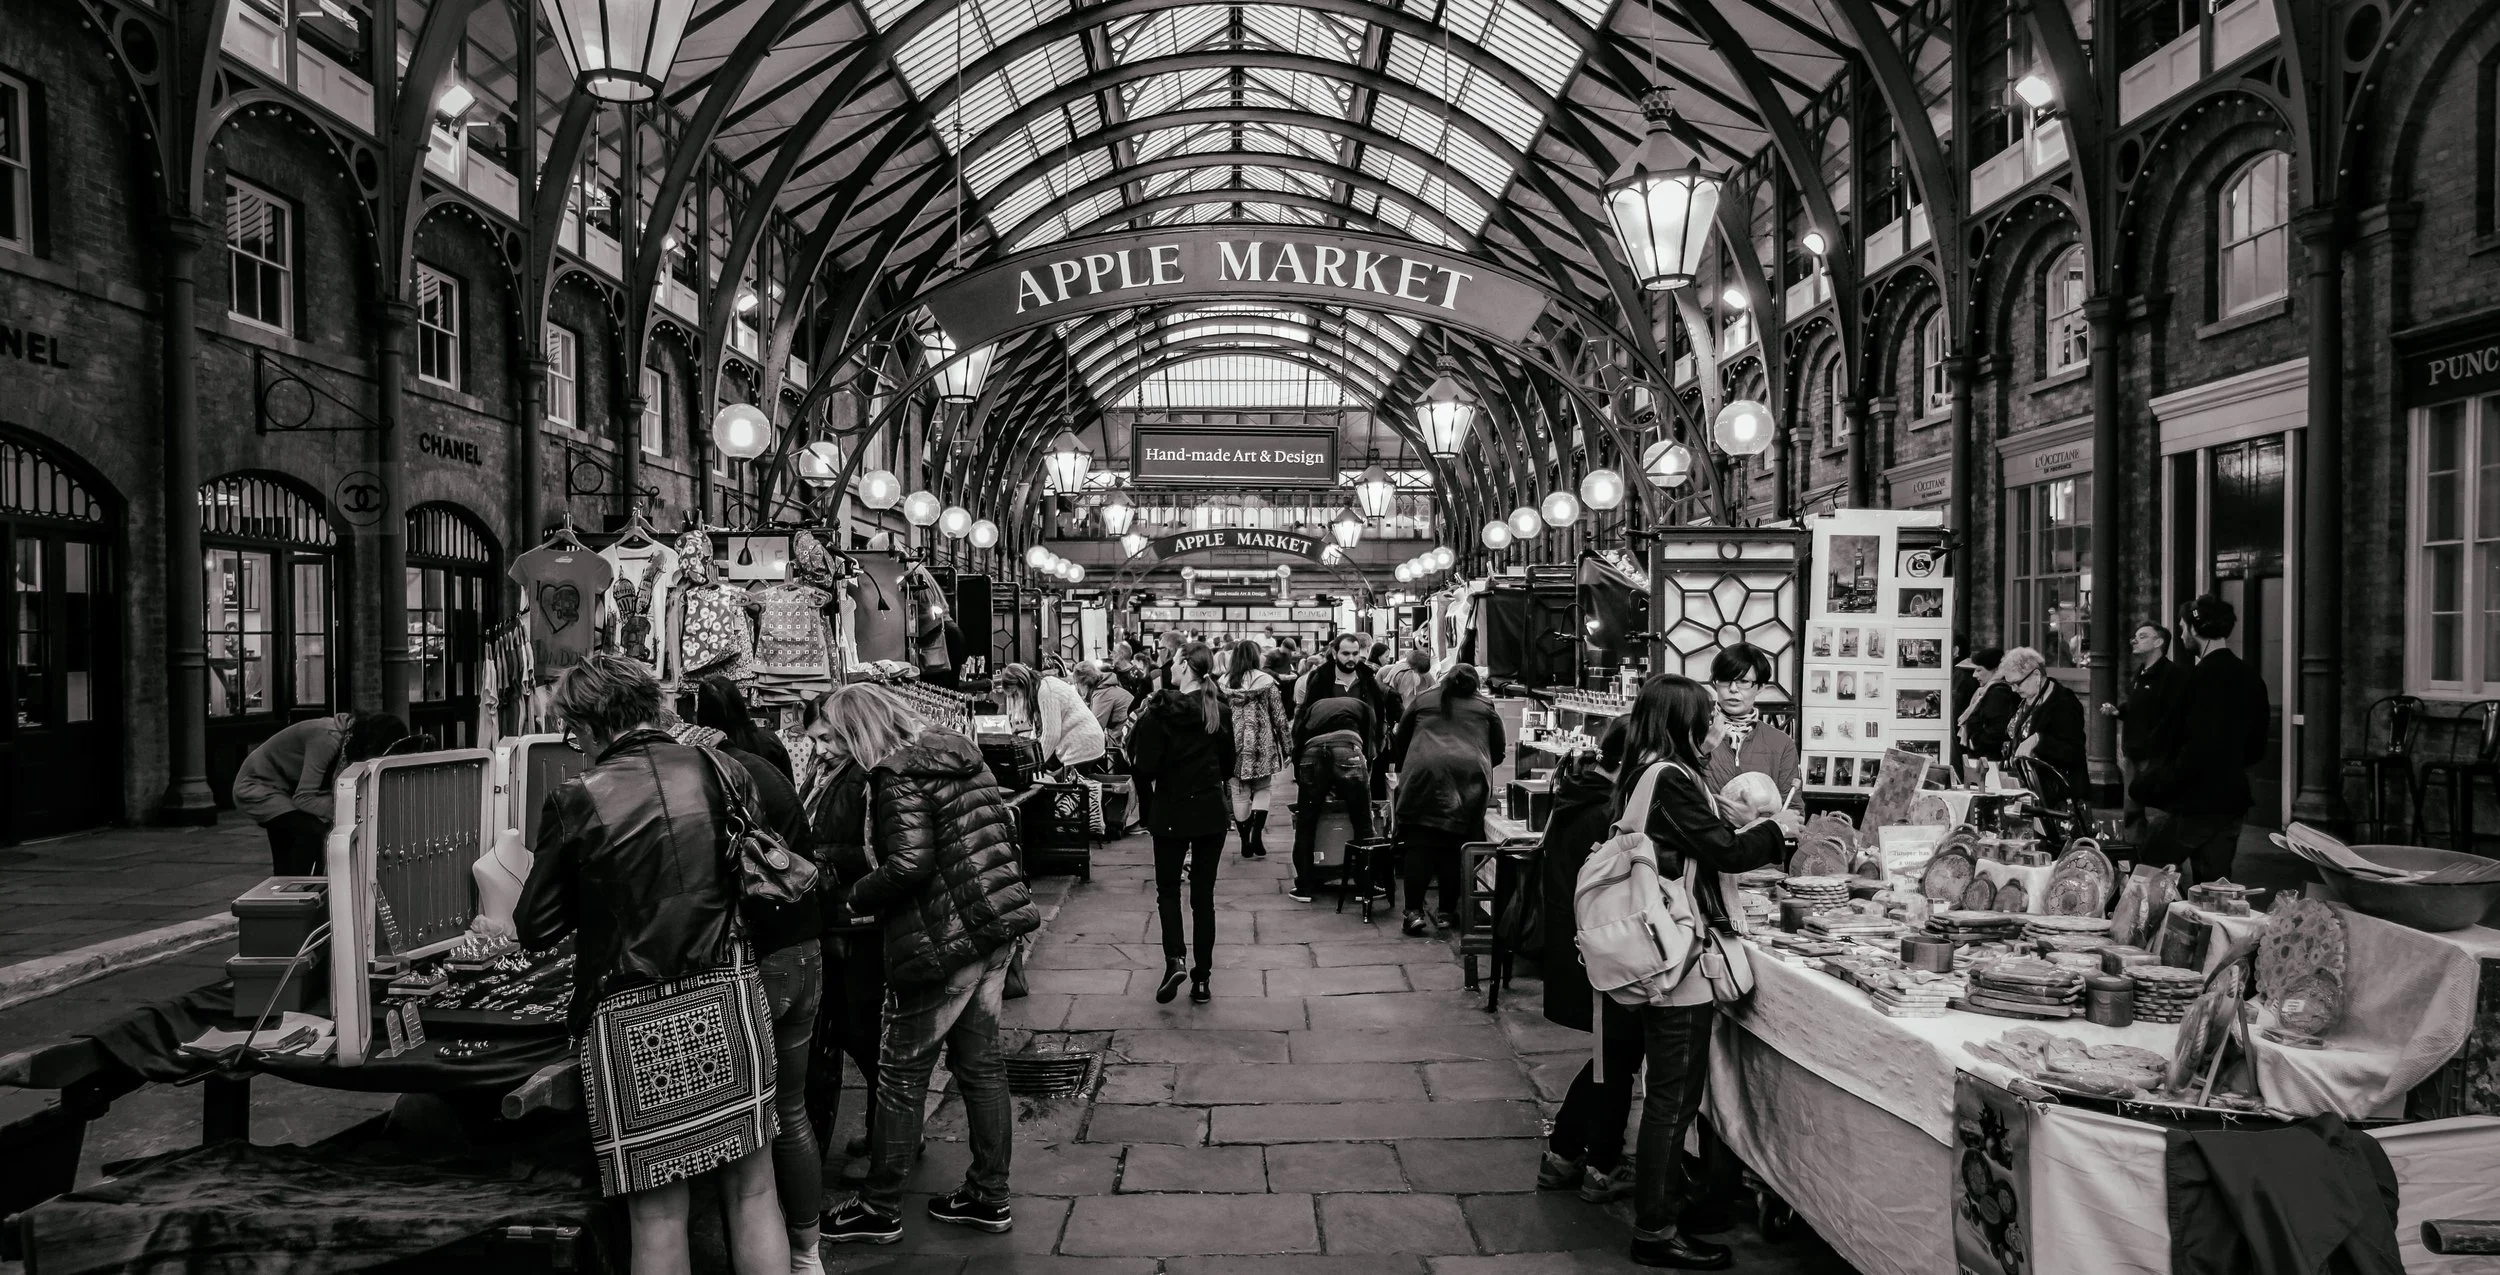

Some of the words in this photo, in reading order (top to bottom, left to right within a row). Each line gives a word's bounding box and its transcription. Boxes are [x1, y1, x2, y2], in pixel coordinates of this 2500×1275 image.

[1015, 244, 1185, 314] APPLE
[1217, 241, 1473, 312] MARKET
[420, 432, 482, 466] CHANEL
[1145, 448, 1231, 463] Hand-made
[1232, 449, 1257, 463] Art
[1259, 450, 1271, 463] &
[1273, 450, 1325, 466] Design
[2035, 448, 2080, 468] L'OCCITANE
[1175, 533, 1225, 553] APPLE
[1237, 532, 1312, 554] MARKET
